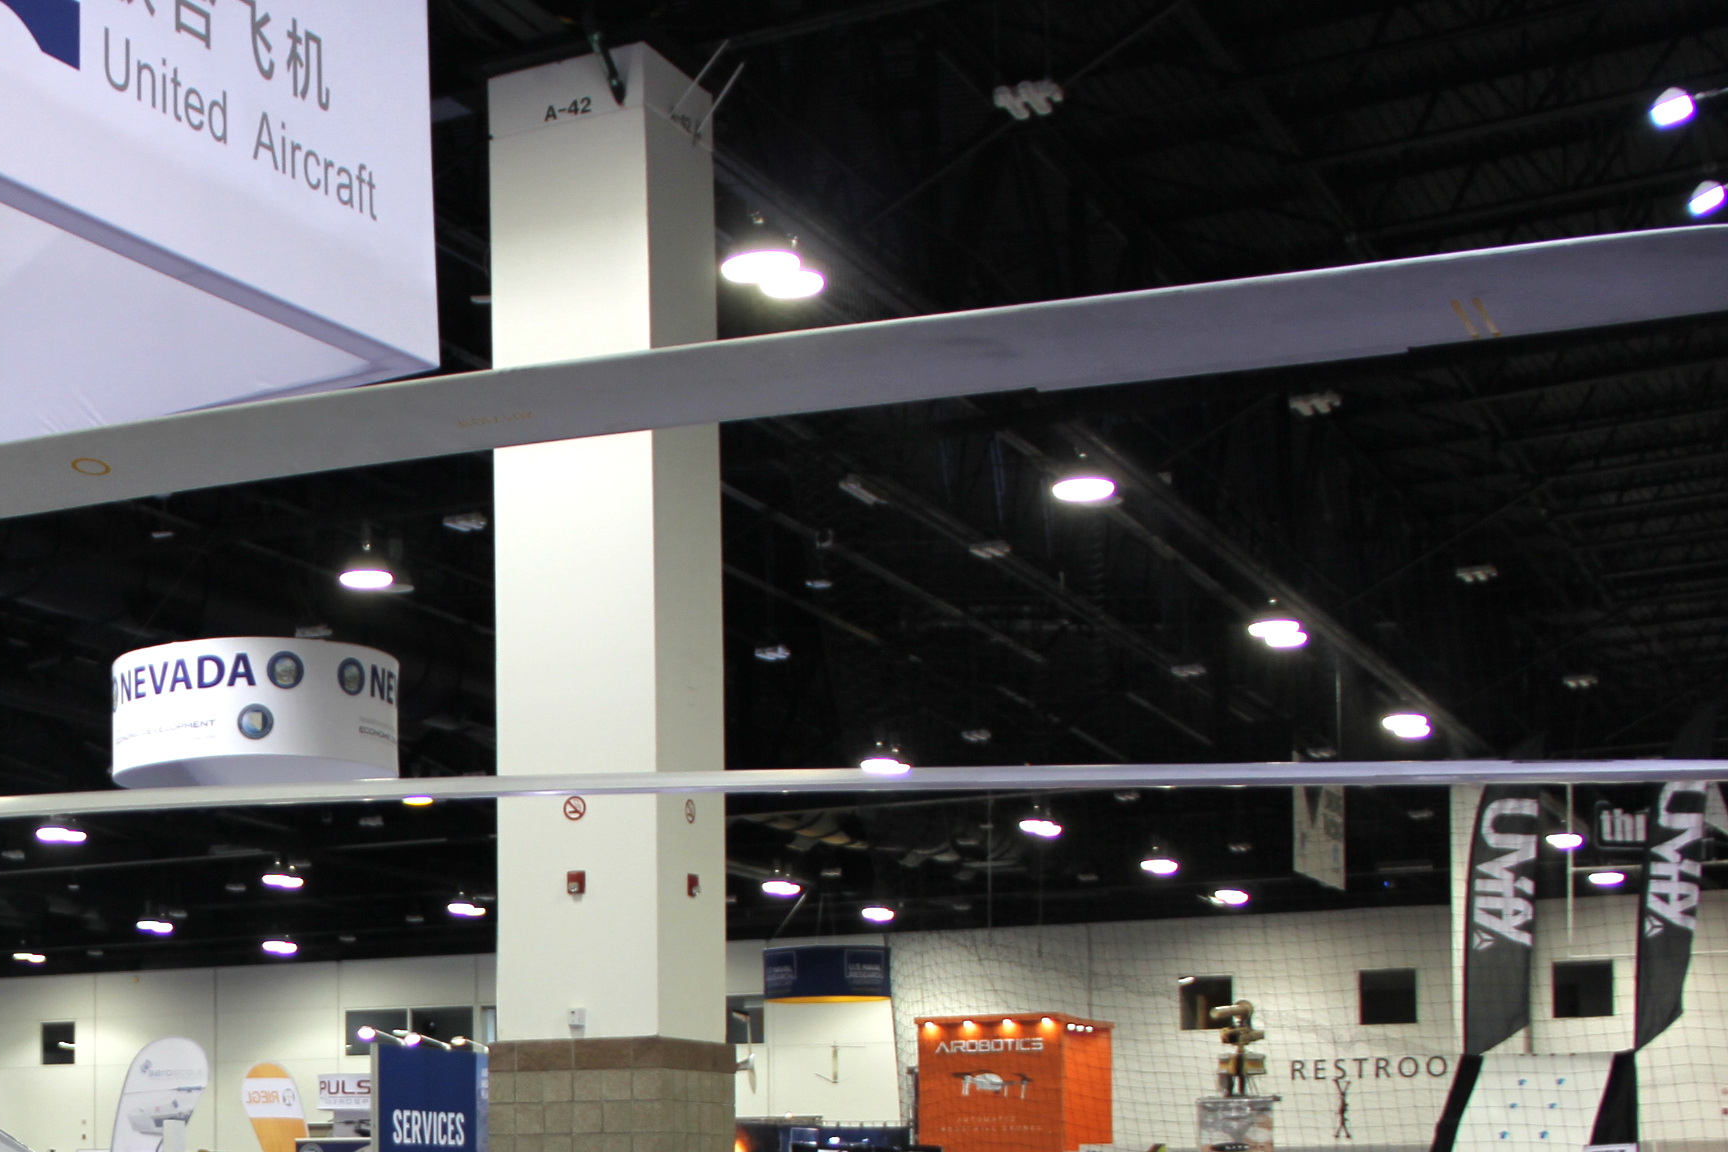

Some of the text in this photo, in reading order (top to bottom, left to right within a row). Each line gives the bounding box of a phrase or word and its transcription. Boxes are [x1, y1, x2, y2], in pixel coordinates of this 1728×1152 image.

[119, 0, 330, 111] 合飞机
[104, 26, 377, 221] United Aircraft
[544, 96, 591, 122] A-42
[121, 652, 256, 704] NEVADA
[935, 1037, 1044, 1053] AIROBOTICS
[1290, 1056, 1447, 1080] RESTROO
[392, 1108, 465, 1146] SERVICES
